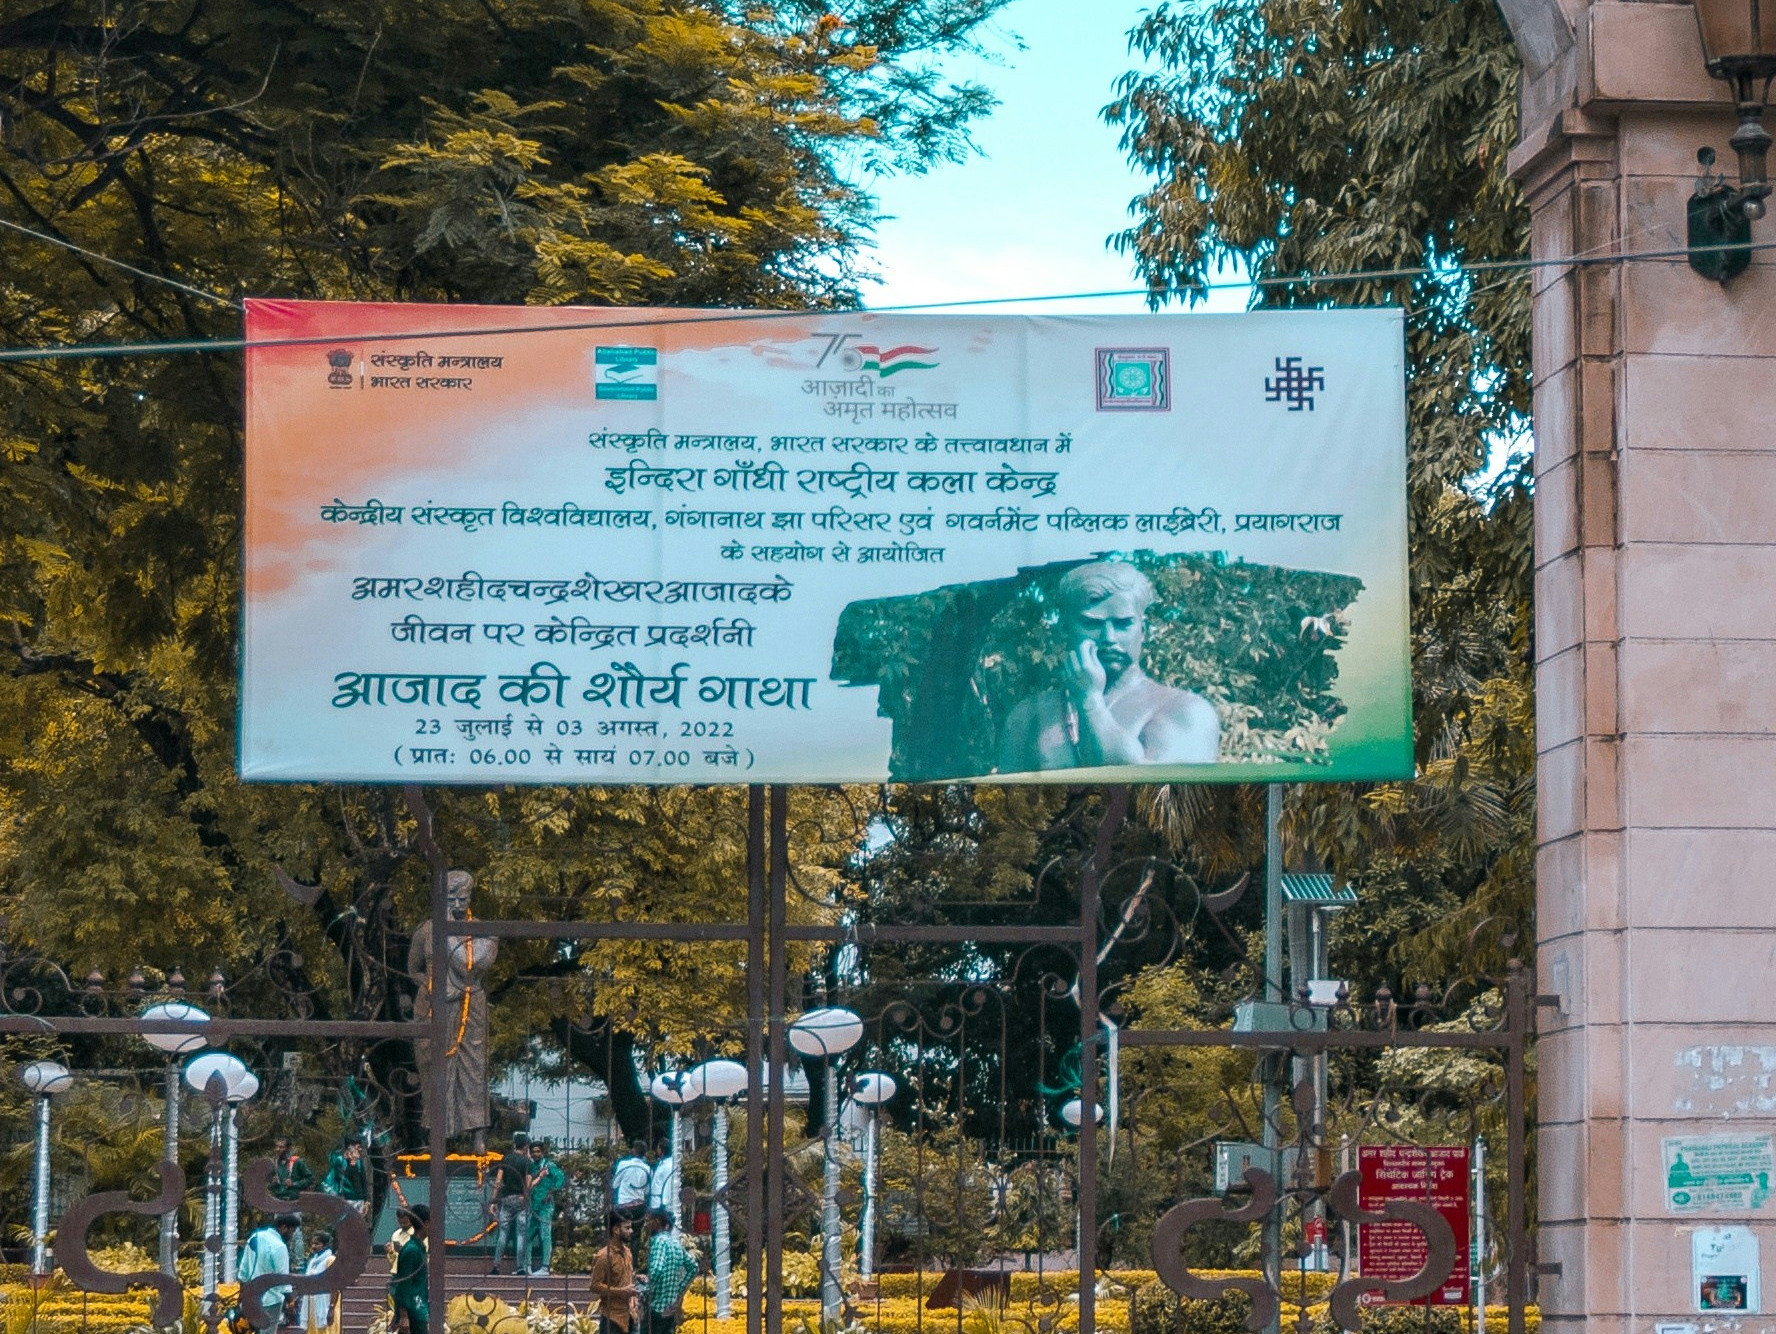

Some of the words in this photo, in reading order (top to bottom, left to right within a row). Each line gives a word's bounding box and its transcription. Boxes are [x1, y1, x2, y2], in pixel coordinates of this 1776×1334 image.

[370, 349, 434, 371] संस्कृति
[438, 353, 505, 370] मन्त्रालय
[370, 375, 412, 390] भारत
[415, 376, 474, 391] सरकार
[876, 383, 897, 399] का
[823, 399, 874, 425] अमृत
[881, 395, 959, 421] महोत्सव
[588, 427, 669, 453] संस्कृति
[674, 432, 763, 453] मन्त्रालय,
[770, 432, 824, 452] भारत
[832, 435, 910, 454] सरकार
[915, 431, 940, 453] के
[944, 435, 1049, 455] तत्त्वावधान
[1054, 431, 1074, 454] में
[604, 457, 709, 496] इन्दिरा
[713, 458, 789, 493] गाँधी
[796, 461, 901, 500] राष्ट्रीय
[907, 470, 979, 495] कला
[985, 462, 1061, 499] केन्द्र
[319, 497, 407, 527] केन्द्रीय
[411, 499, 496, 533] संस्कृत
[664, 503, 763, 531] गंगानाथ
[770, 511, 805, 530] झा
[809, 505, 893, 533] परिसर
[899, 506, 935, 534] एवं
[945, 504, 1041, 533] गवर्नमेंट
[1046, 506, 1131, 534] पब्लिक
[1233, 512, 1345, 535] प्रयागराज
[720, 540, 745, 562] के
[750, 540, 826, 563] सहयोग
[831, 540, 853, 563] से
[857, 542, 948, 565] आयोजित
[390, 613, 475, 647] जीवन
[482, 622, 527, 648] पर
[533, 615, 642, 651] केन्द्रित
[643, 616, 758, 650] प्रदर्शनी
[331, 670, 488, 711] आजाद
[497, 660, 572, 709] की
[582, 660, 693, 709] शौर्य
[698, 673, 819, 712] गाथा
[414, 718, 443, 736] 23
[453, 713, 514, 742] जुलाई
[525, 712, 545, 736] से
[555, 718, 584, 737] 03
[596, 718, 669, 740] अगस्त,
[679, 719, 736, 739] 2022
[468, 748, 533, 767] 06.00
[543, 745, 565, 765] से
[573, 745, 618, 766] सायं
[628, 749, 692, 768] 07.00
